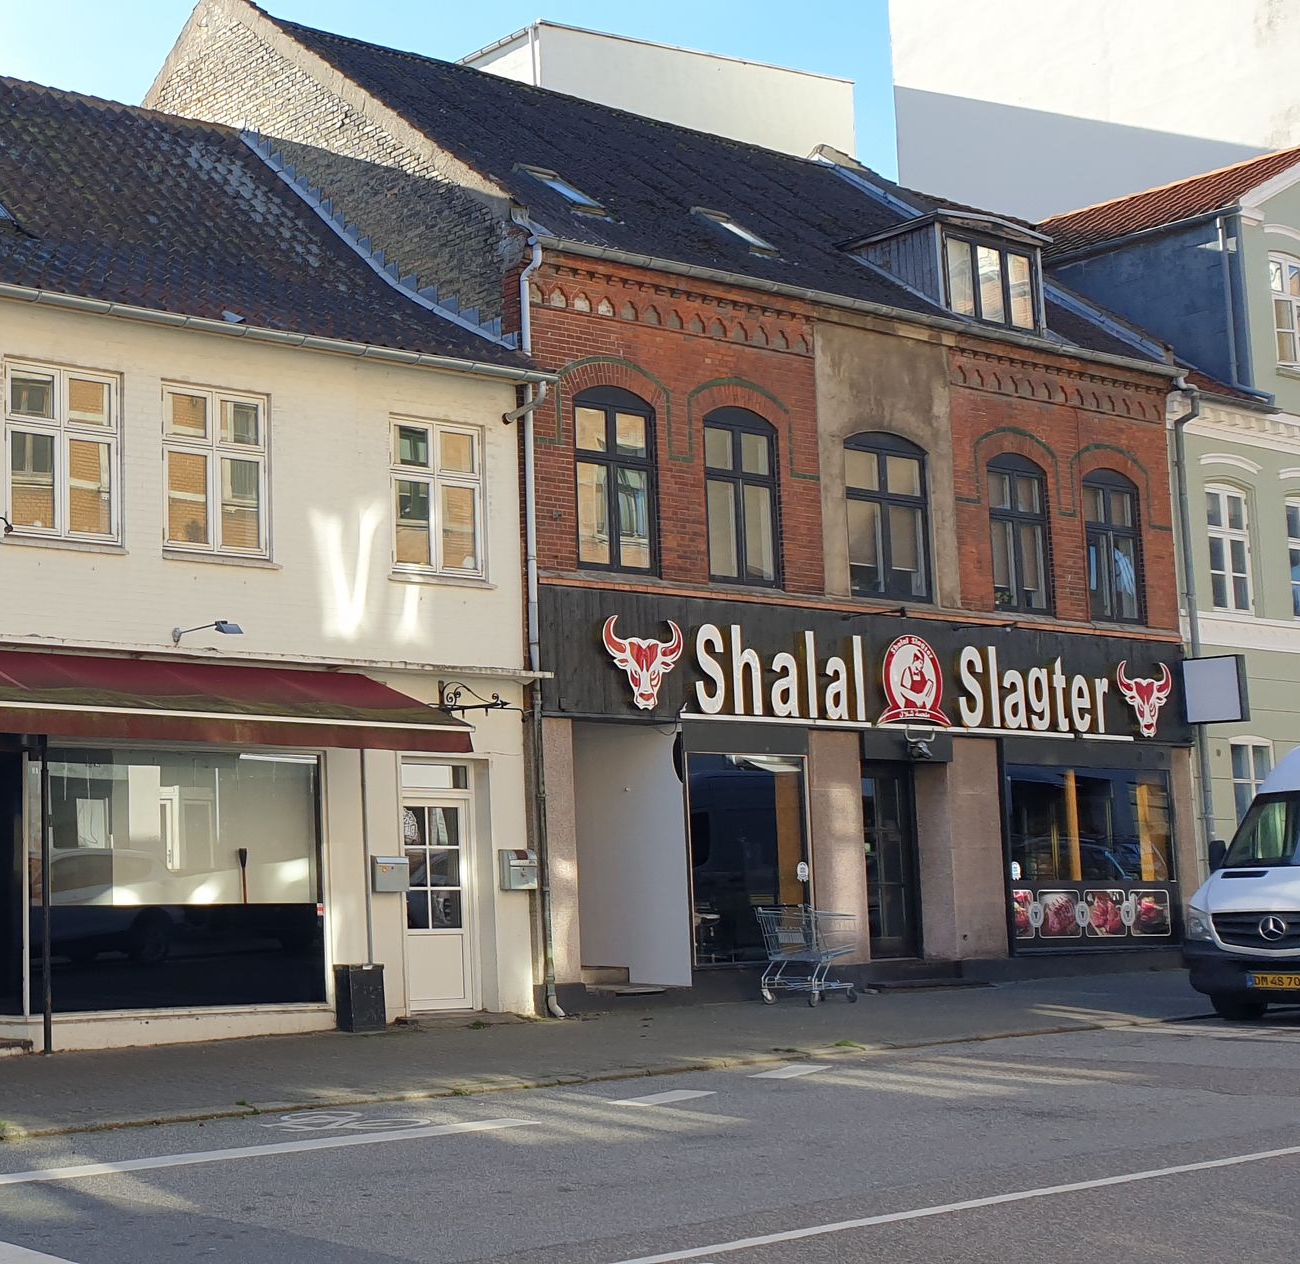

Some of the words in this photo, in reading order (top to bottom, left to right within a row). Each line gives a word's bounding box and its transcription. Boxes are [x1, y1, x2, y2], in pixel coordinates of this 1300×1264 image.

[890, 637, 909, 655] Shalal
[911, 637, 933, 658] Slagter
[695, 623, 866, 721] Shalal
[958, 645, 1108, 733] Slagter
[1253, 976, 1268, 986] DM
